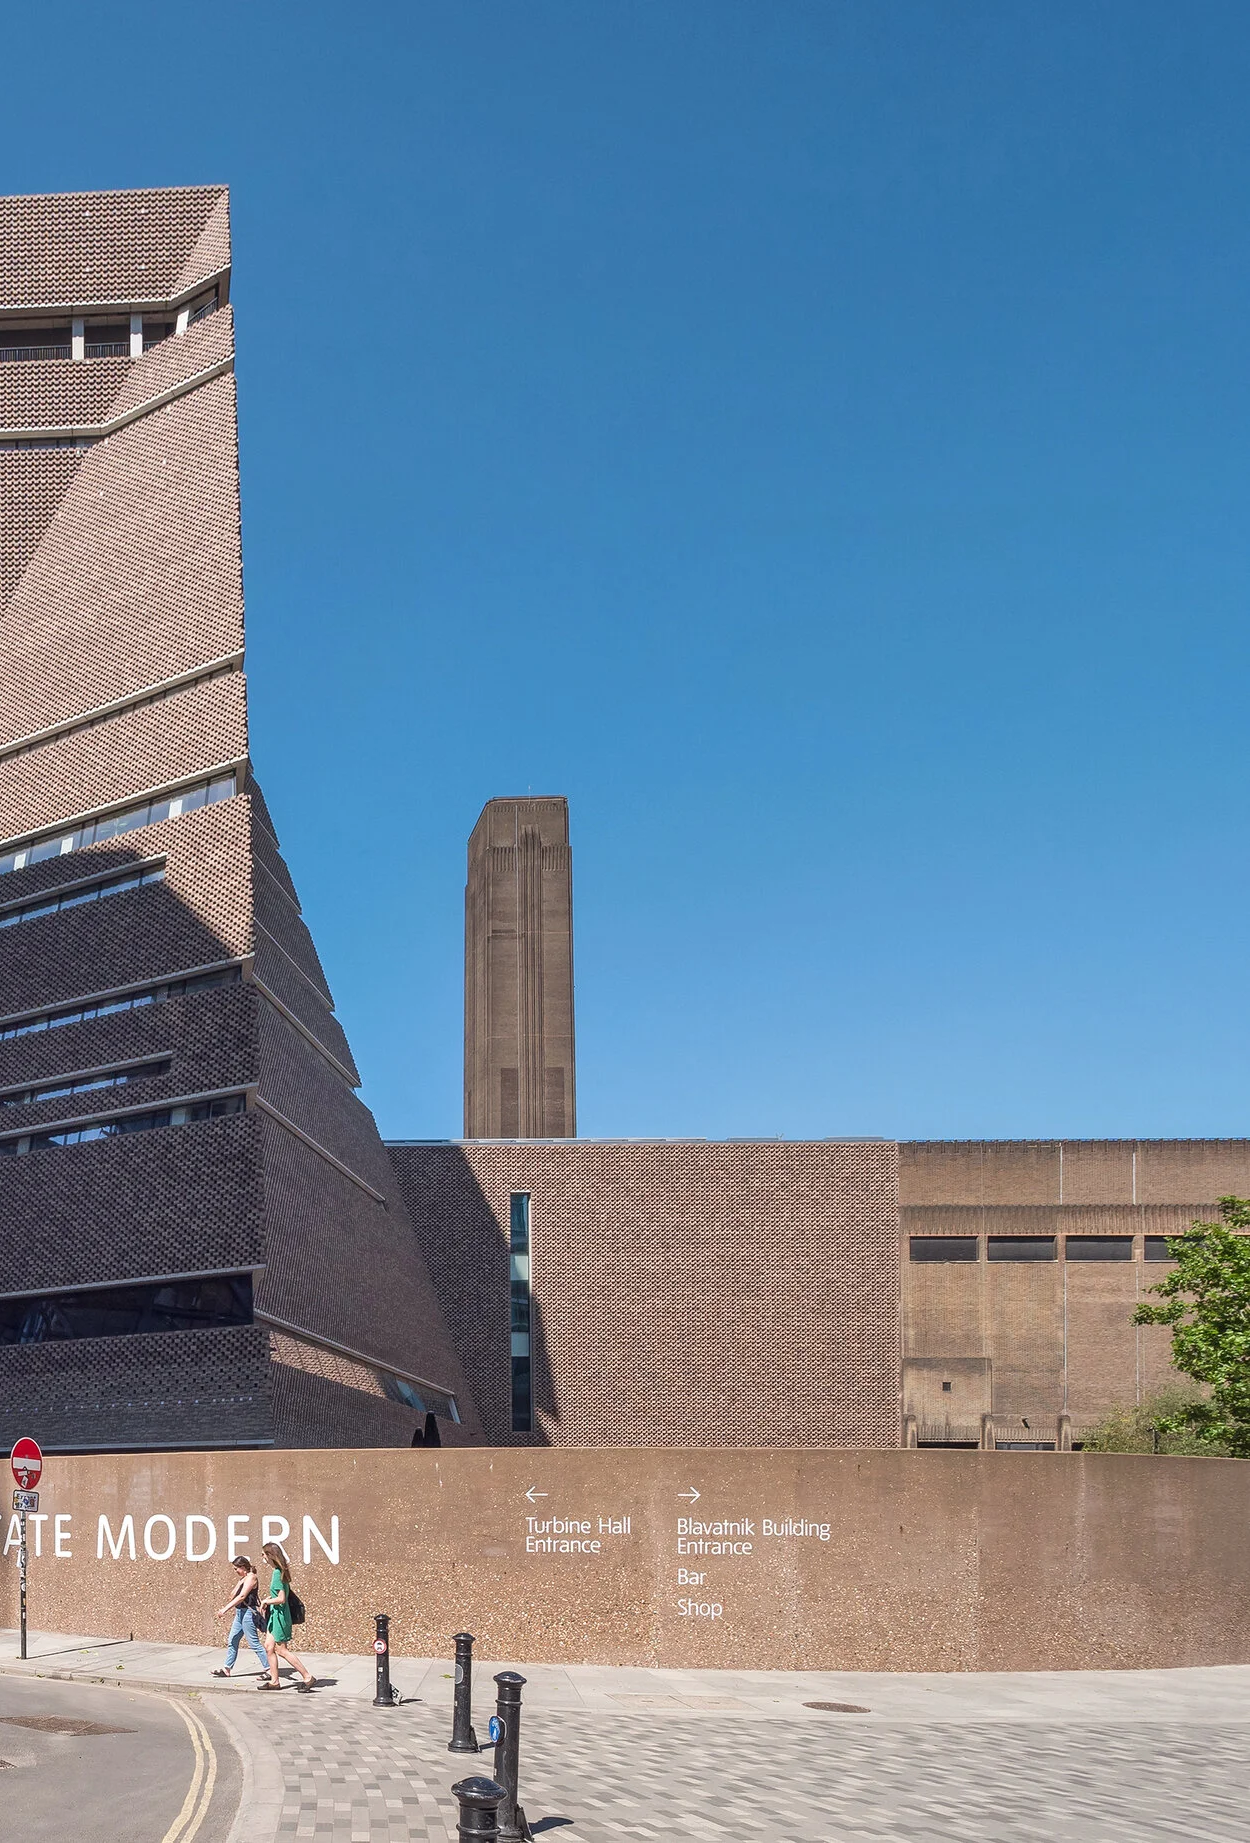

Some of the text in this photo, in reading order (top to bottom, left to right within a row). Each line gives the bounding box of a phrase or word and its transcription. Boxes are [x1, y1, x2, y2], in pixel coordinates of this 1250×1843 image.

[525, 1516, 631, 1535] Turbine Hall
[677, 1518, 831, 1541] Blavatnik Building
[96, 1513, 340, 1566] MODERN
[525, 1536, 601, 1553] Entrance
[677, 1538, 753, 1555] Entrance
[677, 1568, 707, 1585] Bar
[677, 1599, 723, 1620] Shop
